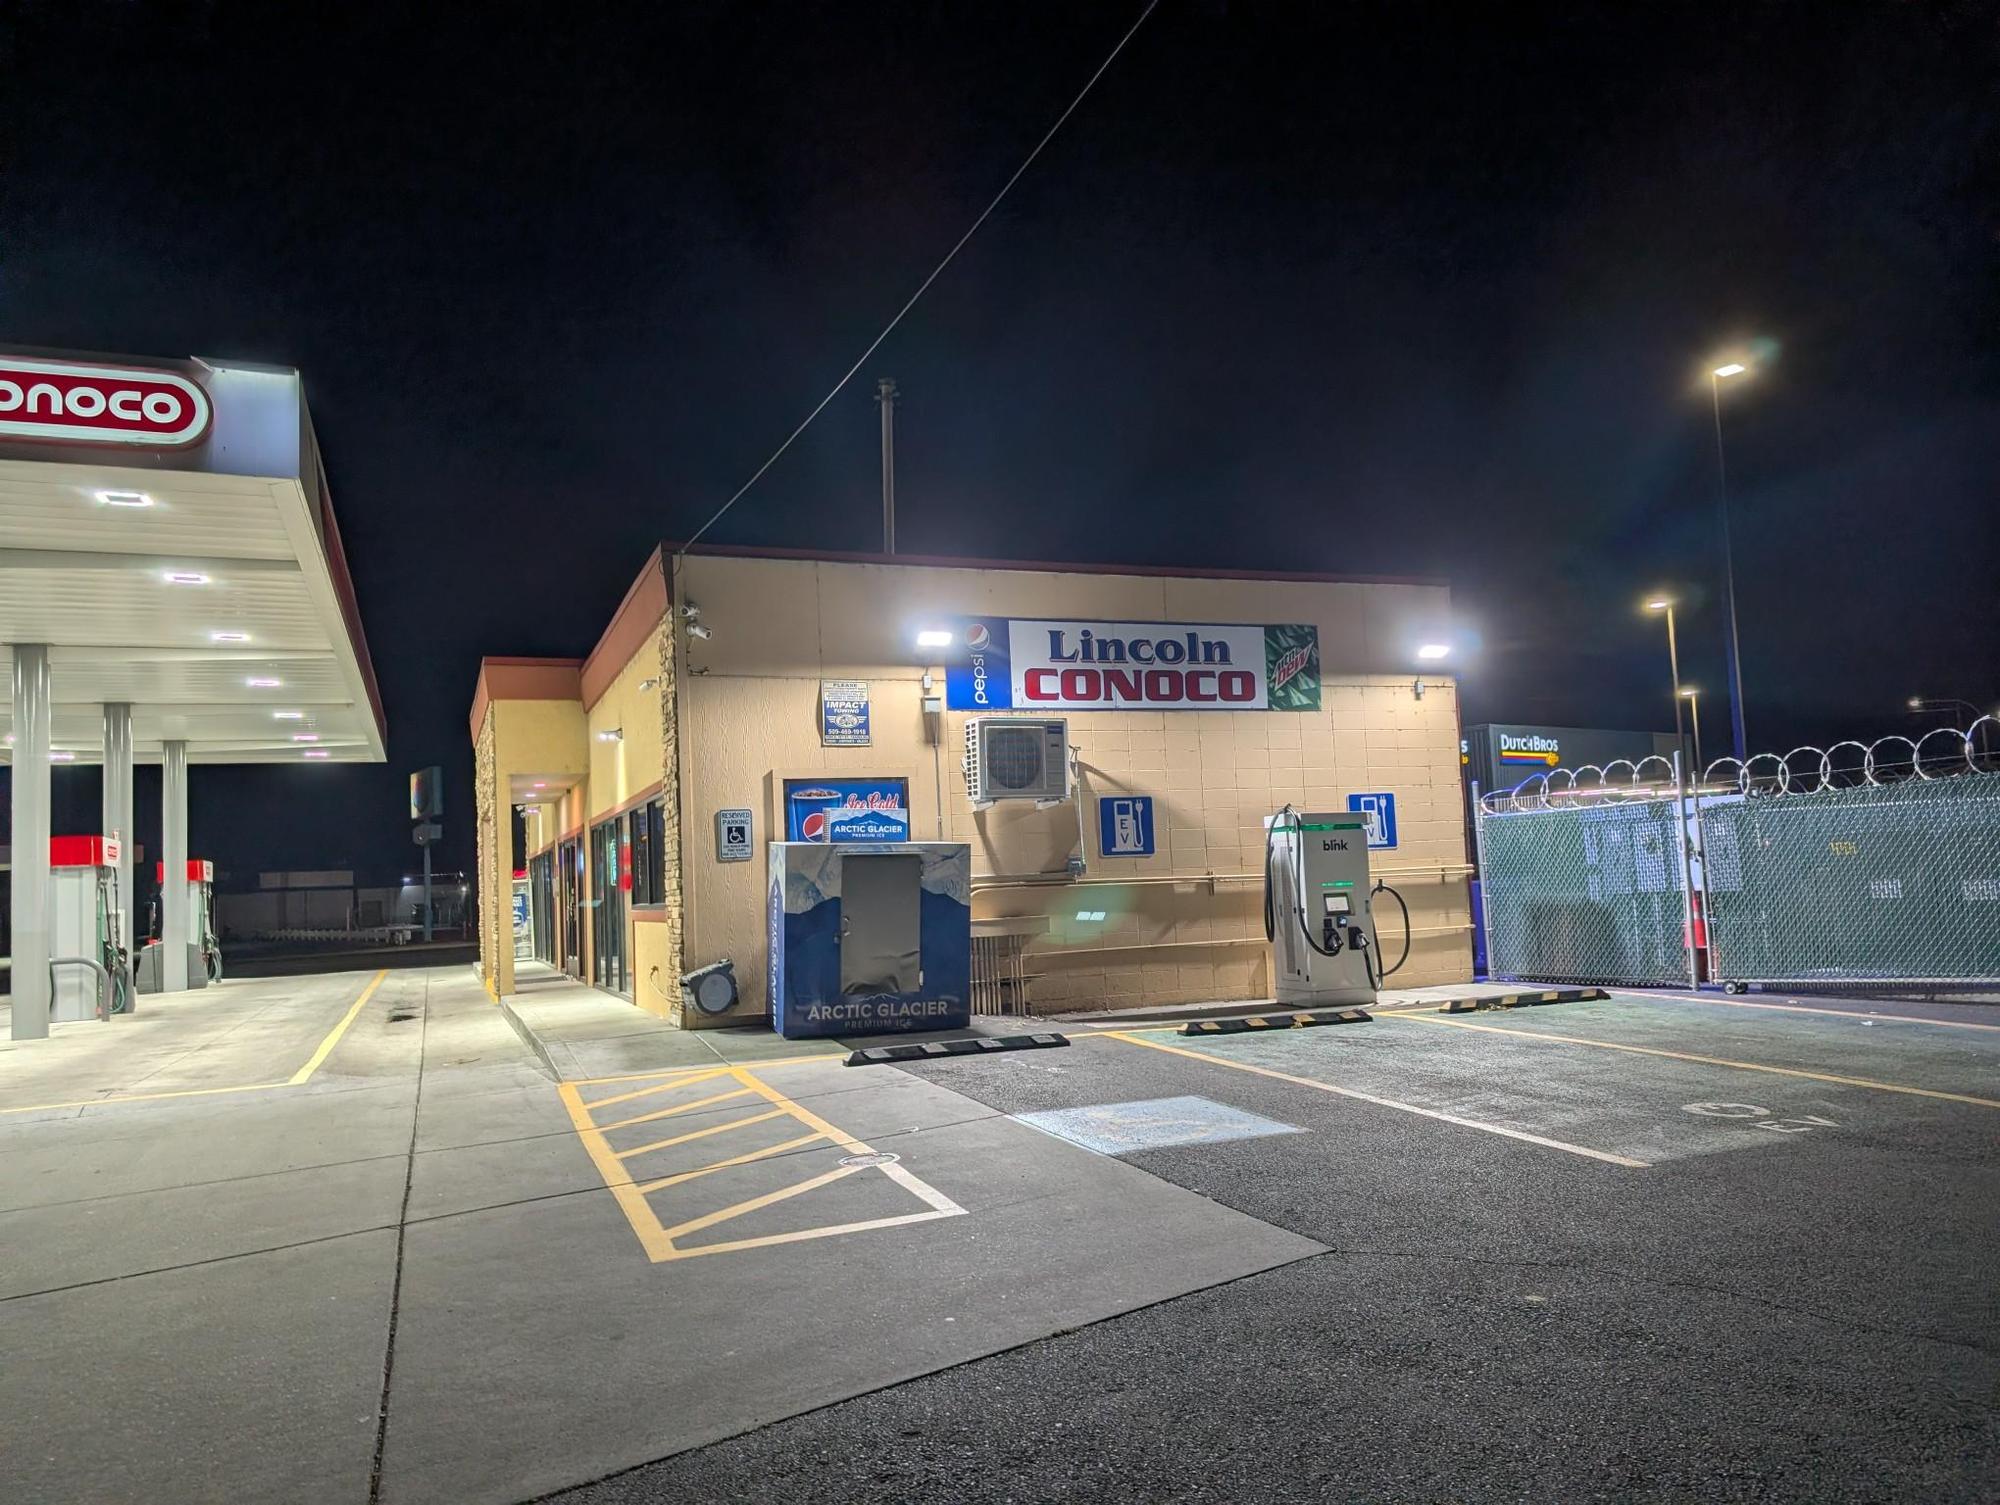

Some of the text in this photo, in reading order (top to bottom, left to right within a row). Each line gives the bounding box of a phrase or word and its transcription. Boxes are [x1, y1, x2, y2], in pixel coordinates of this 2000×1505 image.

[1047, 629, 1233, 665] Lincoln
[970, 654, 988, 704] pepsi
[1024, 667, 1256, 702] CONOCO
[826, 701, 867, 709] IMPACT
[1533, 735, 1559, 752] BROS
[844, 791, 900, 809] Ice Cold
[834, 825, 903, 833] ARCTIC GLACIER
[1322, 839, 1349, 851] blink
[808, 1001, 948, 1020] ARCTIC GLACIER
[844, 1018, 913, 1029] PREMIUM ICE
